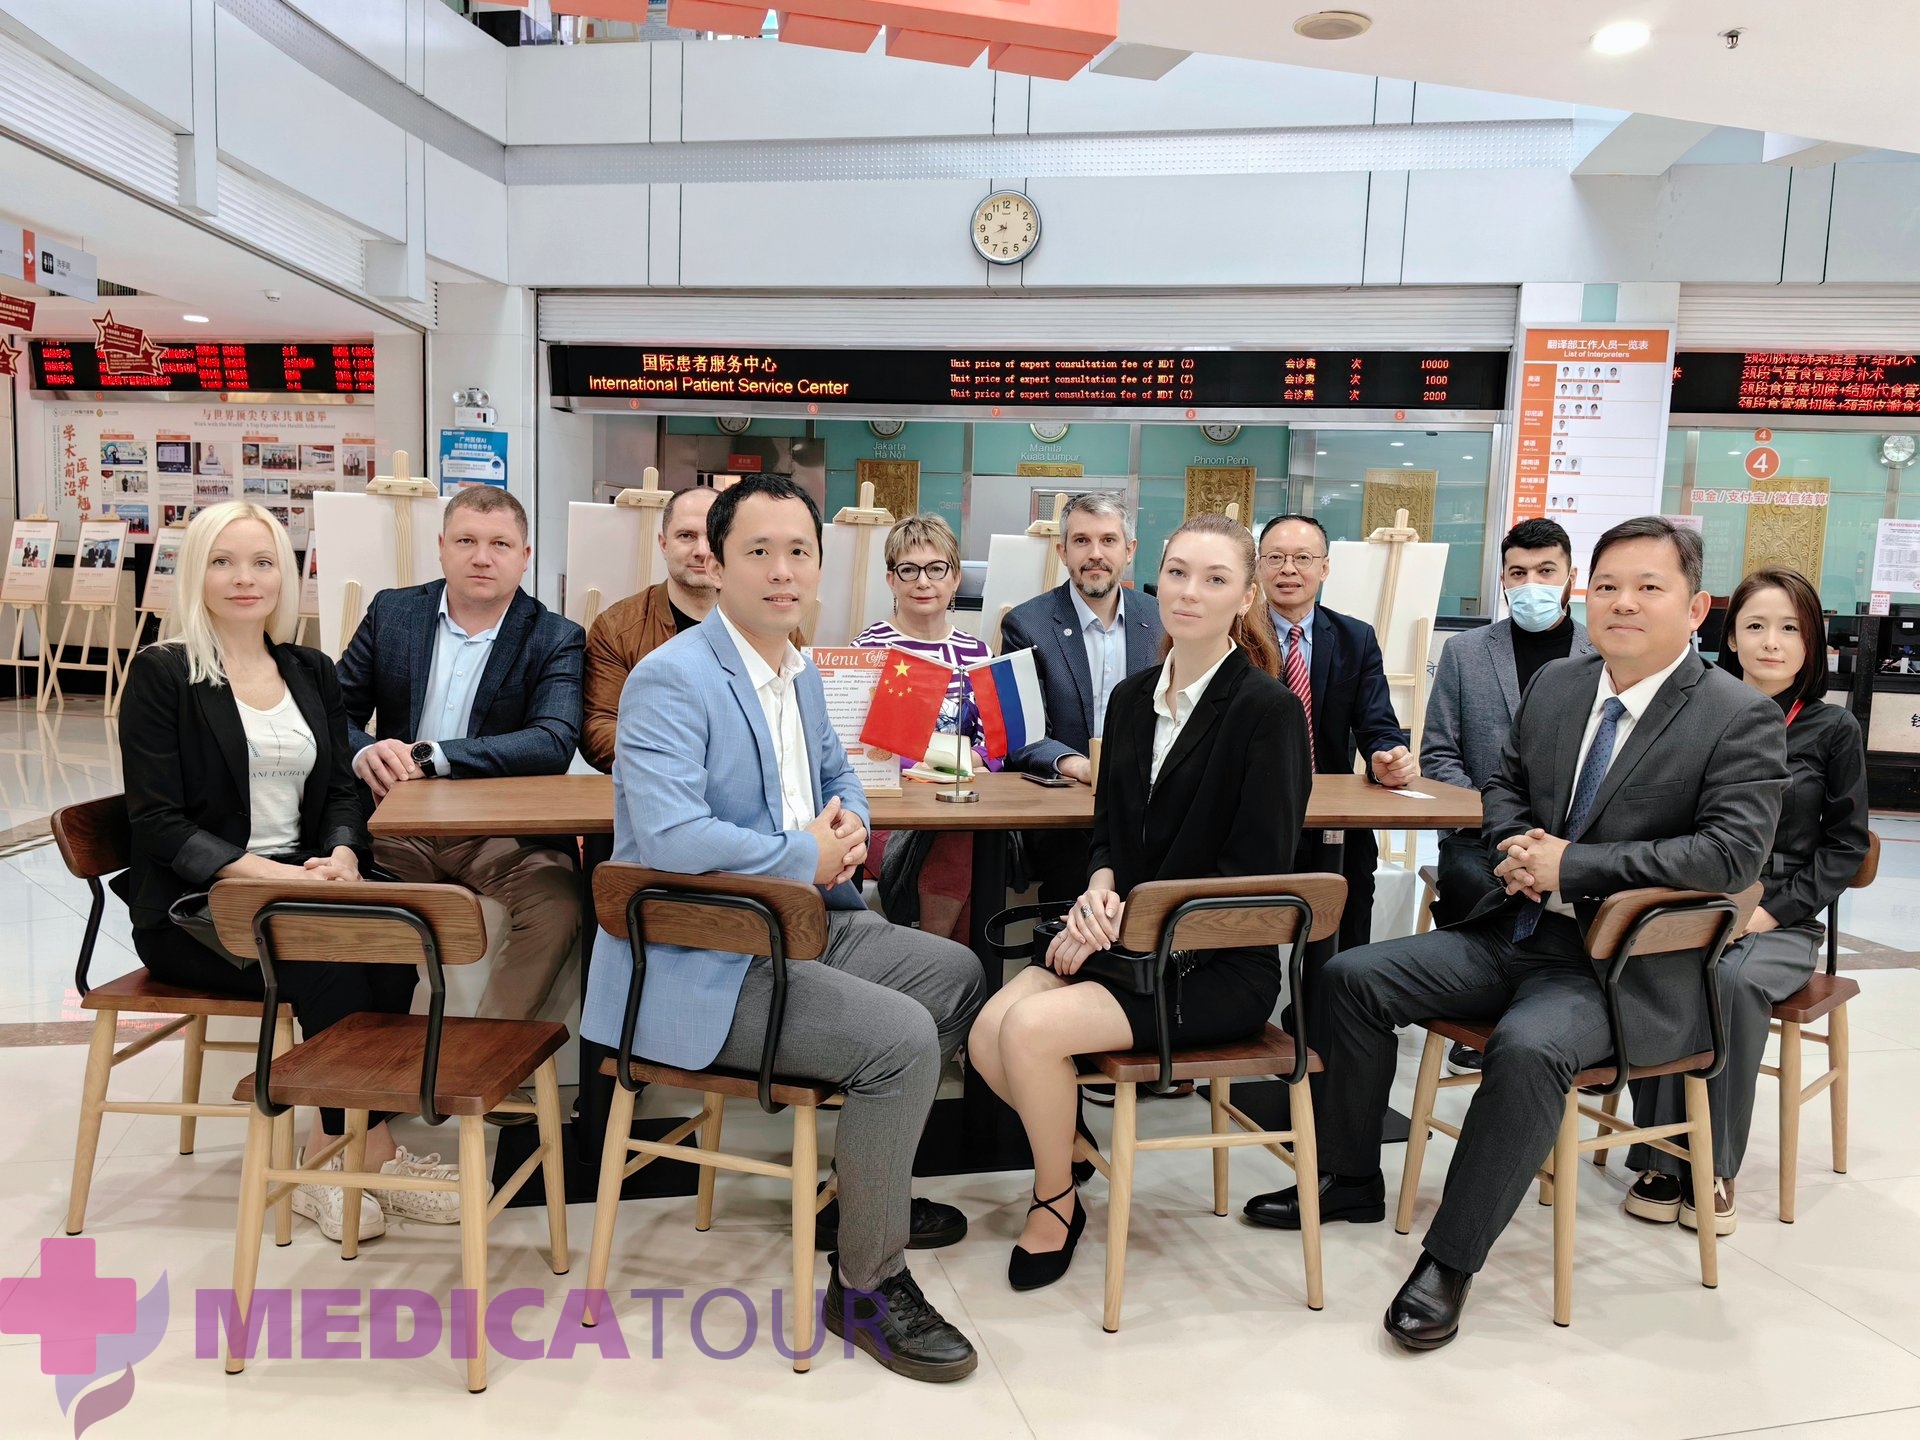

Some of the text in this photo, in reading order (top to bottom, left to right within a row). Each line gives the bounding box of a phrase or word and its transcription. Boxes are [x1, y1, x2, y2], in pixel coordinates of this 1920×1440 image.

[992, 204, 1000, 213] 11
[1002, 200, 1011, 209] 12
[1016, 203, 1020, 212] 1
[984, 212, 993, 221] 10
[1022, 211, 1029, 220] 2
[979, 224, 986, 232] 9
[1026, 222, 1032, 231] 3
[983, 235, 990, 244] 8
[1021, 234, 1028, 243] 4
[992, 243, 998, 252] 7
[1002, 246, 1009, 255] 6
[1013, 243, 1019, 252] 5
[1546, 339, 1649, 350] 翻译部工作人员一览表
[1563, 350, 1630, 359] List of Interpreters
[642, 353, 778, 374] 国际患者服务中心
[950, 359, 971, 368] Unit
[974, 360, 1001, 369] price
[1005, 360, 1016, 368] of
[1020, 361, 1051, 370] expert
[1055, 360, 1118, 369] consultation
[1121, 360, 1138, 368] fee
[1142, 360, 1154, 368] of
[1180, 359, 1195, 369] (Z)
[1285, 357, 1317, 370] 会诊费
[1350, 358, 1362, 370] 次
[1420, 359, 1449, 369] 10000
[950, 374, 971, 383] Unit
[974, 375, 1001, 385] price
[1005, 374, 1016, 383] of
[1019, 376, 1050, 385] expert
[1054, 375, 1117, 384] consultation
[1120, 375, 1138, 383] fee
[1142, 375, 1153, 383] of
[1180, 374, 1194, 384] (Z)
[1284, 373, 1316, 385] 会诊费
[1349, 374, 1361, 385] 次
[1425, 375, 1448, 385] 1000
[589, 375, 849, 395] International Patient Service Center
[1738, 381, 1920, 398] 颈段食管癌切除+结肠代食管
[950, 389, 971, 398] Unit
[974, 389, 1001, 399] price
[1005, 389, 1016, 399] of
[1019, 391, 1050, 400] expert
[1054, 390, 1117, 399] consultation
[1120, 390, 1137, 399] fee
[1141, 390, 1153, 399] of
[1179, 389, 1193, 400] (Z)
[1283, 389, 1315, 401] 会诊费
[1349, 389, 1361, 401] 次
[1423, 391, 1447, 401] 2000
[873, 441, 906, 450] Jakarta
[1029, 443, 1062, 452] Manila
[63, 424, 77, 497] 学术前沿
[1021, 452, 1080, 463] Kuala Lumpur
[1194, 455, 1249, 465] Phnom Penh
[1752, 452, 1769, 473] 4
[815, 652, 859, 666] Menu
